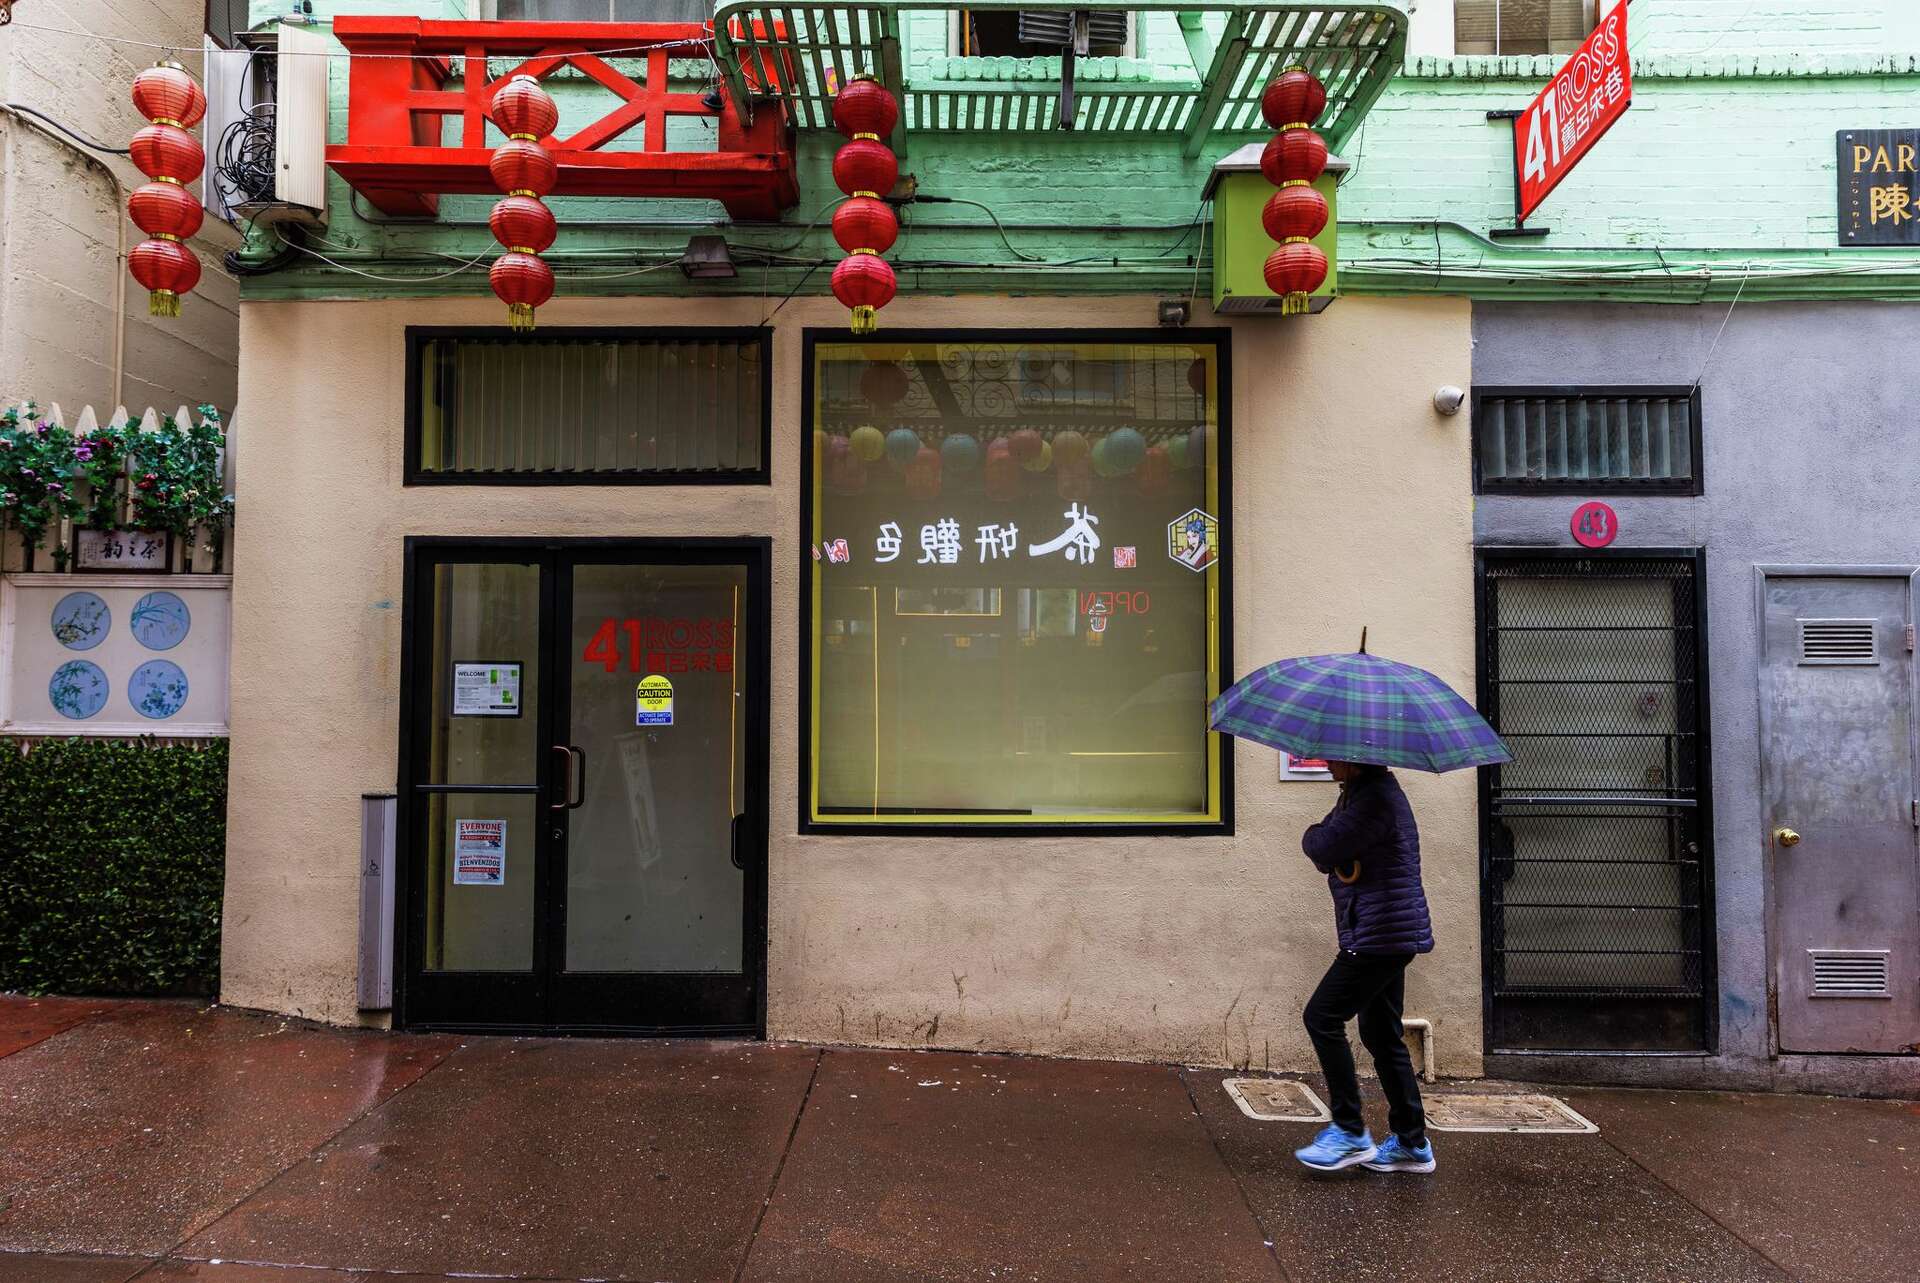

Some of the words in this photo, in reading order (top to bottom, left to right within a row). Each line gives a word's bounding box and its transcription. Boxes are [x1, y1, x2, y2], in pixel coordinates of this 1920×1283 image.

[1524, 87, 1561, 184] 41
[1556, 15, 1619, 123] ROSS
[1870, 182, 1920, 226] 陳
[1579, 509, 1609, 539] 43
[583, 617, 641, 673] 41
[645, 618, 734, 649] ROSS
[638, 690, 671, 698] CAUTION
[460, 823, 502, 831] EVERYONE
